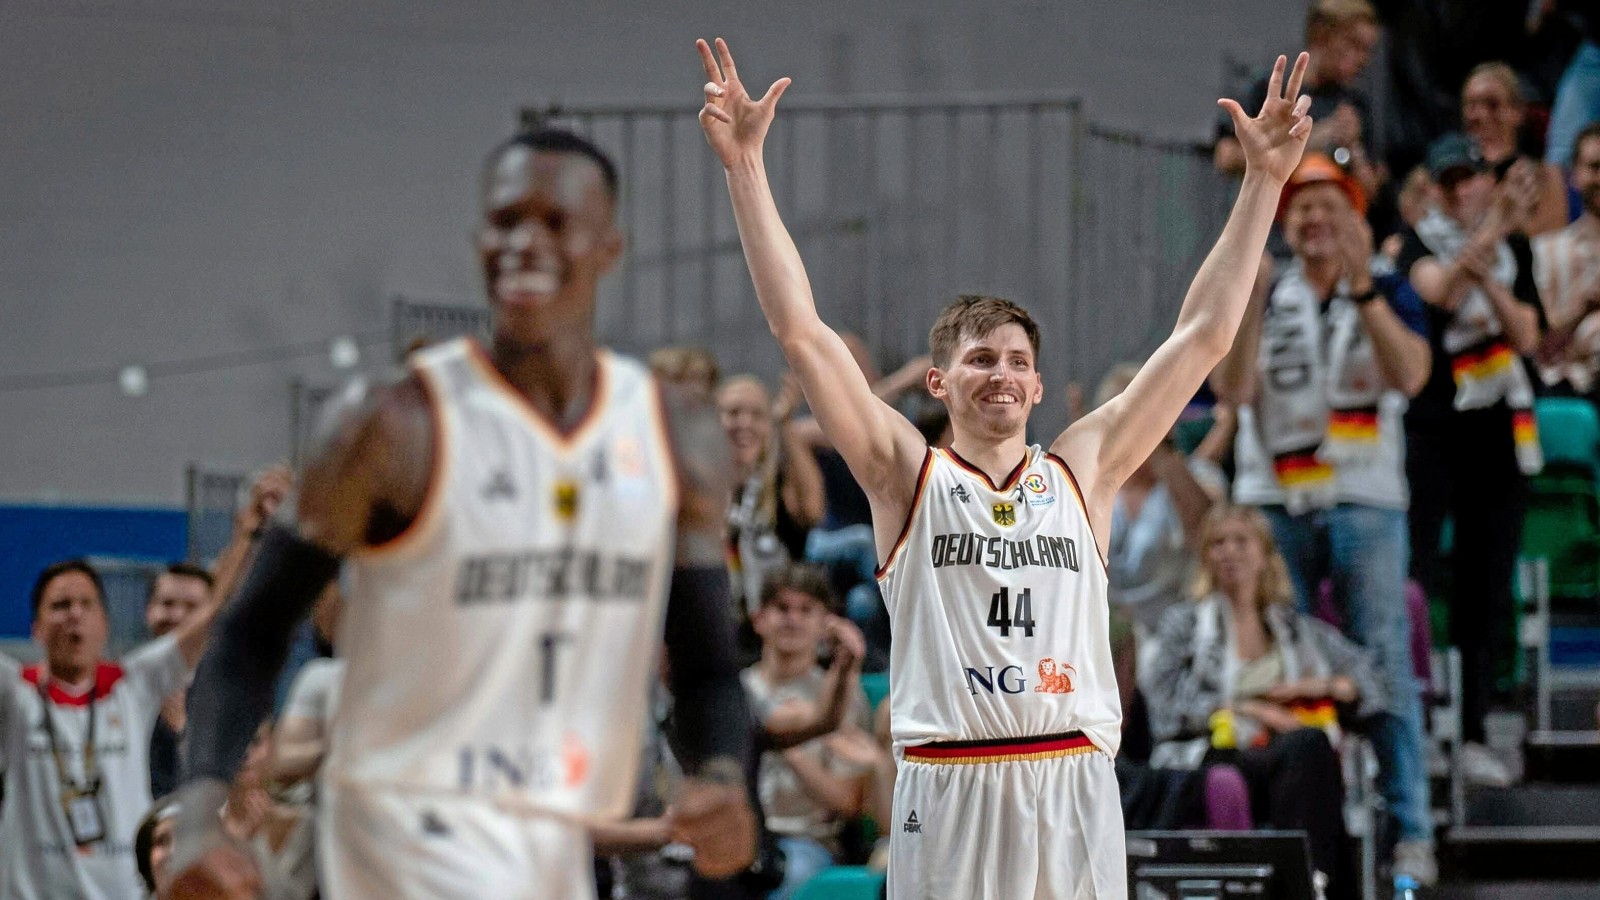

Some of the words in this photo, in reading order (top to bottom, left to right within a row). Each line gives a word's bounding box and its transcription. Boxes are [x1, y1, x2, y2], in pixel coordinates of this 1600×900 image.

[932, 532, 1079, 573] DEUTSCHLAND
[987, 586, 1035, 637] 44
[964, 665, 1027, 696] NG
